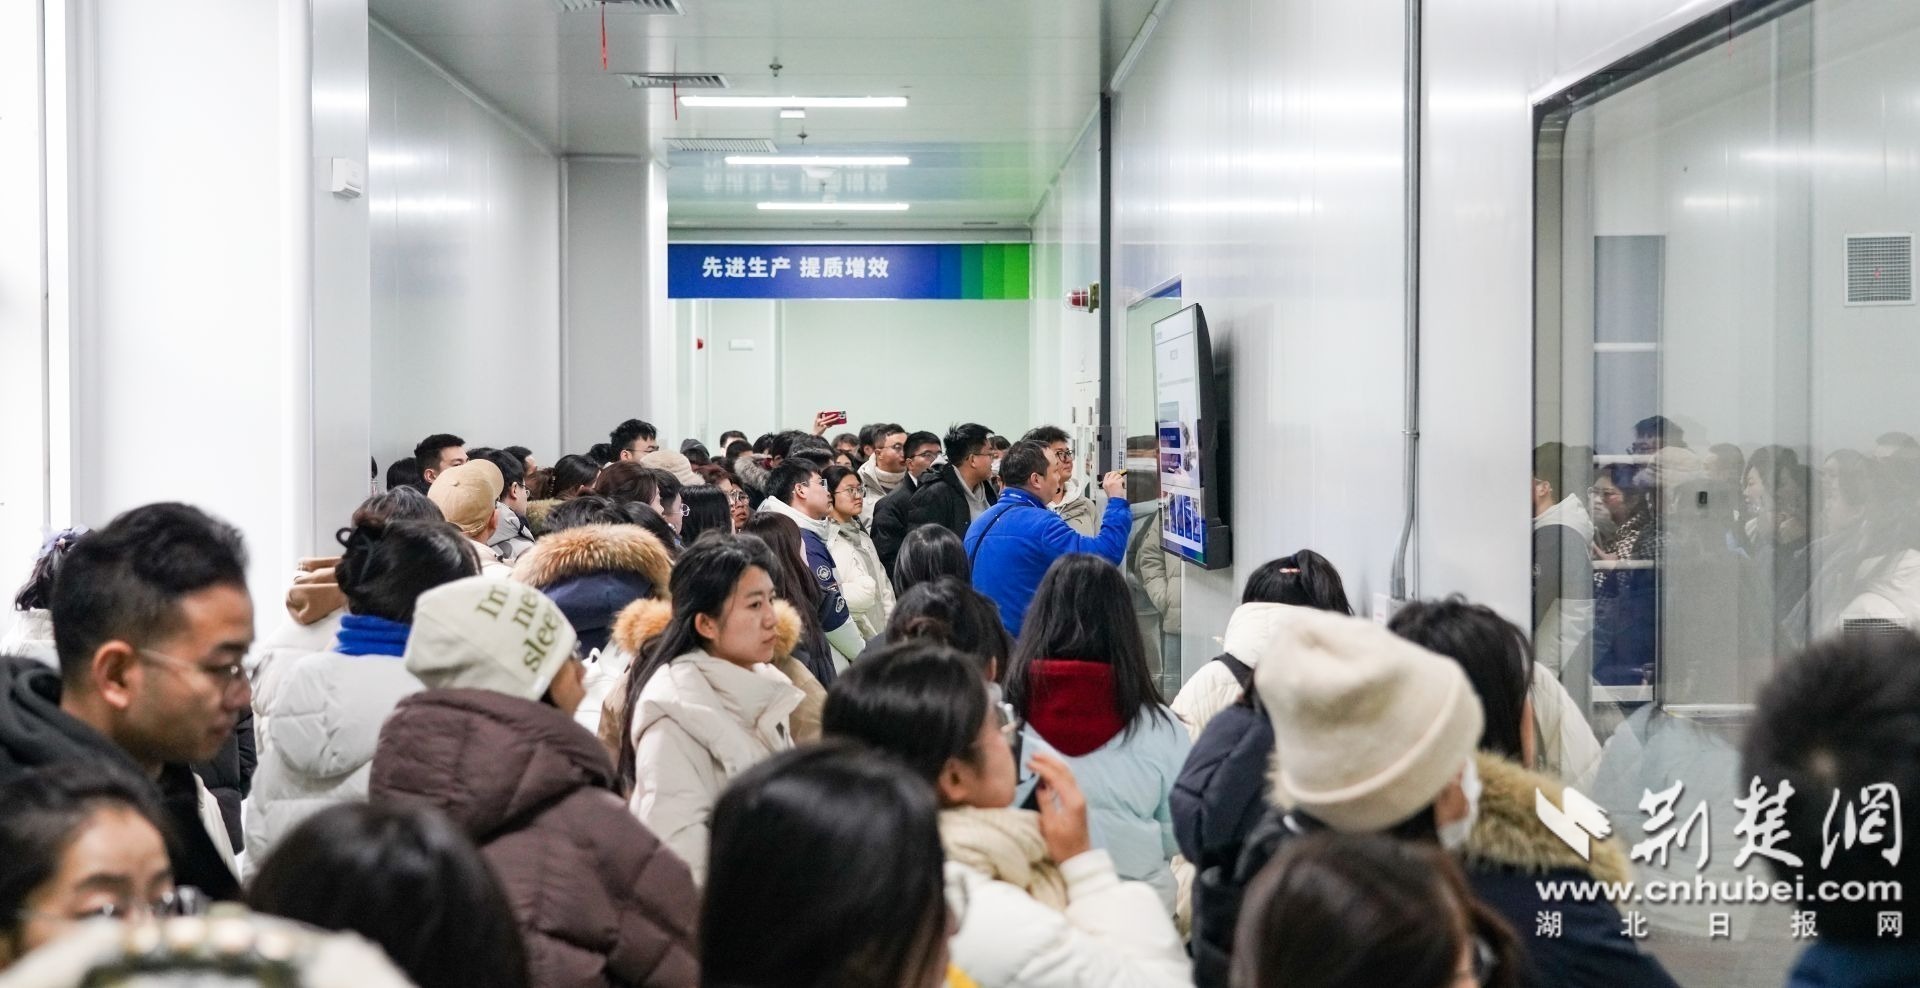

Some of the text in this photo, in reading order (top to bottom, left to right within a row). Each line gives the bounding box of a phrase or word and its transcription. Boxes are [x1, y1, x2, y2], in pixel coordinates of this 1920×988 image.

[702, 256, 890, 279] 先进生产 提质增效
[513, 591, 538, 630] ne
[523, 606, 561, 673] slee
